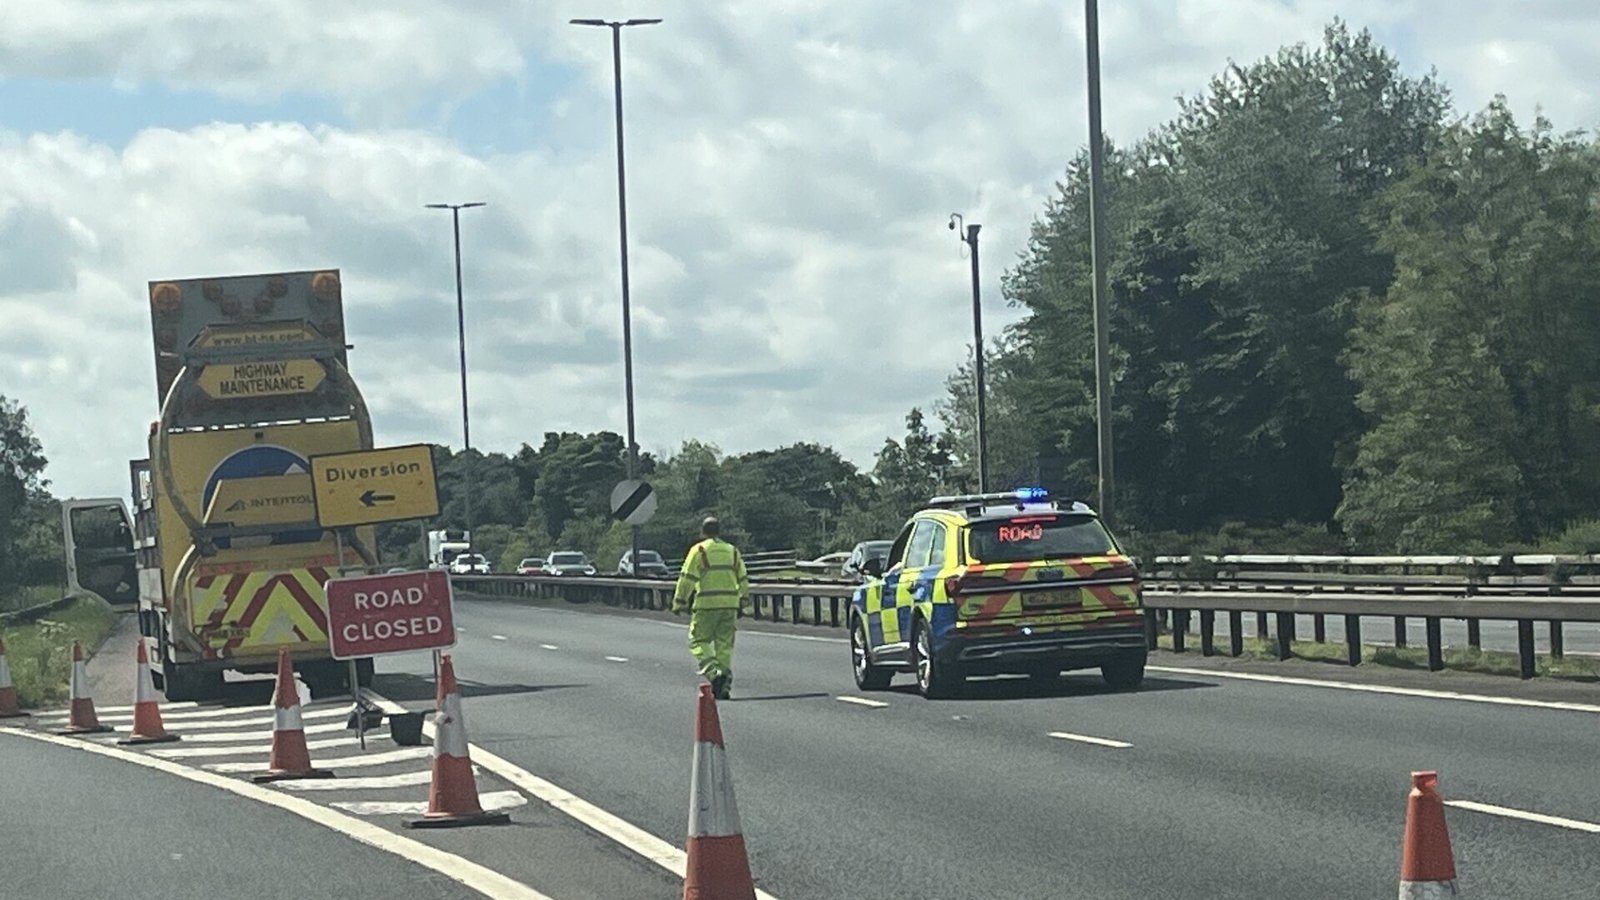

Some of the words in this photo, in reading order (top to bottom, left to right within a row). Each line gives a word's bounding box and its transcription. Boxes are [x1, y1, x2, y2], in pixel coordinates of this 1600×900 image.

[233, 362, 288, 379] HIGHWAY
[219, 375, 305, 395] MAINTENANCE
[325, 461, 420, 482] Diversion
[354, 586, 424, 610] ROAD
[343, 615, 443, 642] CLOSED
